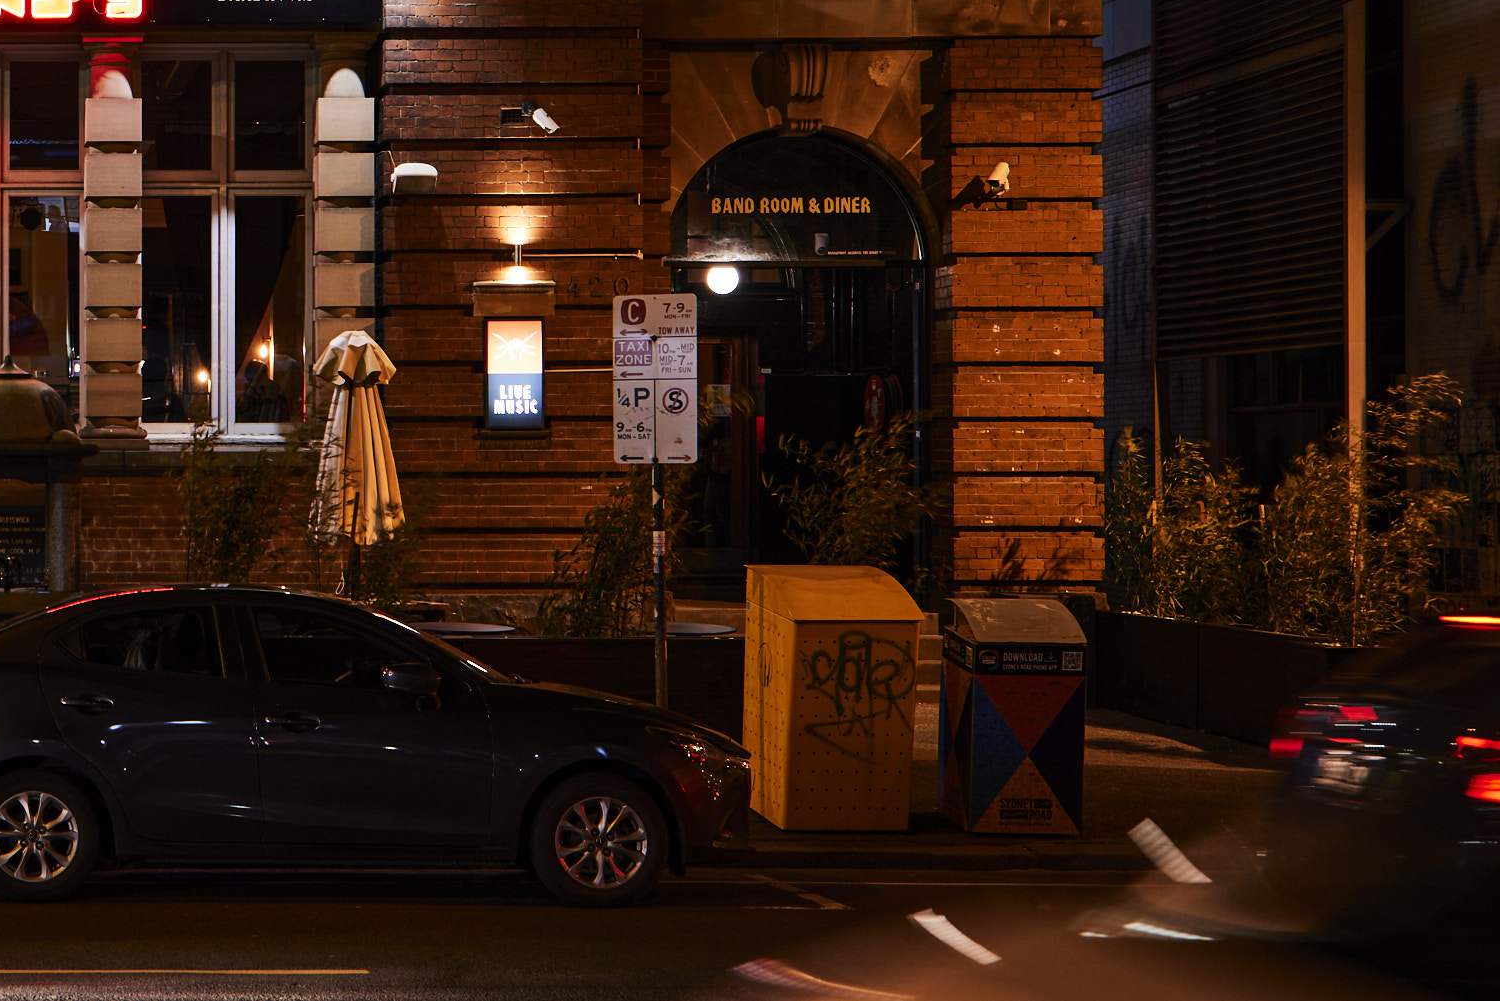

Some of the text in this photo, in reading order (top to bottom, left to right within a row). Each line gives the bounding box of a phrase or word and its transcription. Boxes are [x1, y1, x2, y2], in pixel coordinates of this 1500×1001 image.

[710, 196, 871, 214] BAND ROOM & DINER
[568, 276, 630, 298] 420
[658, 326, 695, 335] TOW AWAY
[618, 341, 650, 352] TAXI
[616, 354, 651, 366] ZONE
[499, 384, 532, 400] LIVE
[493, 399, 539, 415] MUSIC
[1003, 651, 1044, 662] DOWNLOAD
[1000, 798, 1034, 809] SYDNEY
[1029, 809, 1052, 821] ROAD
